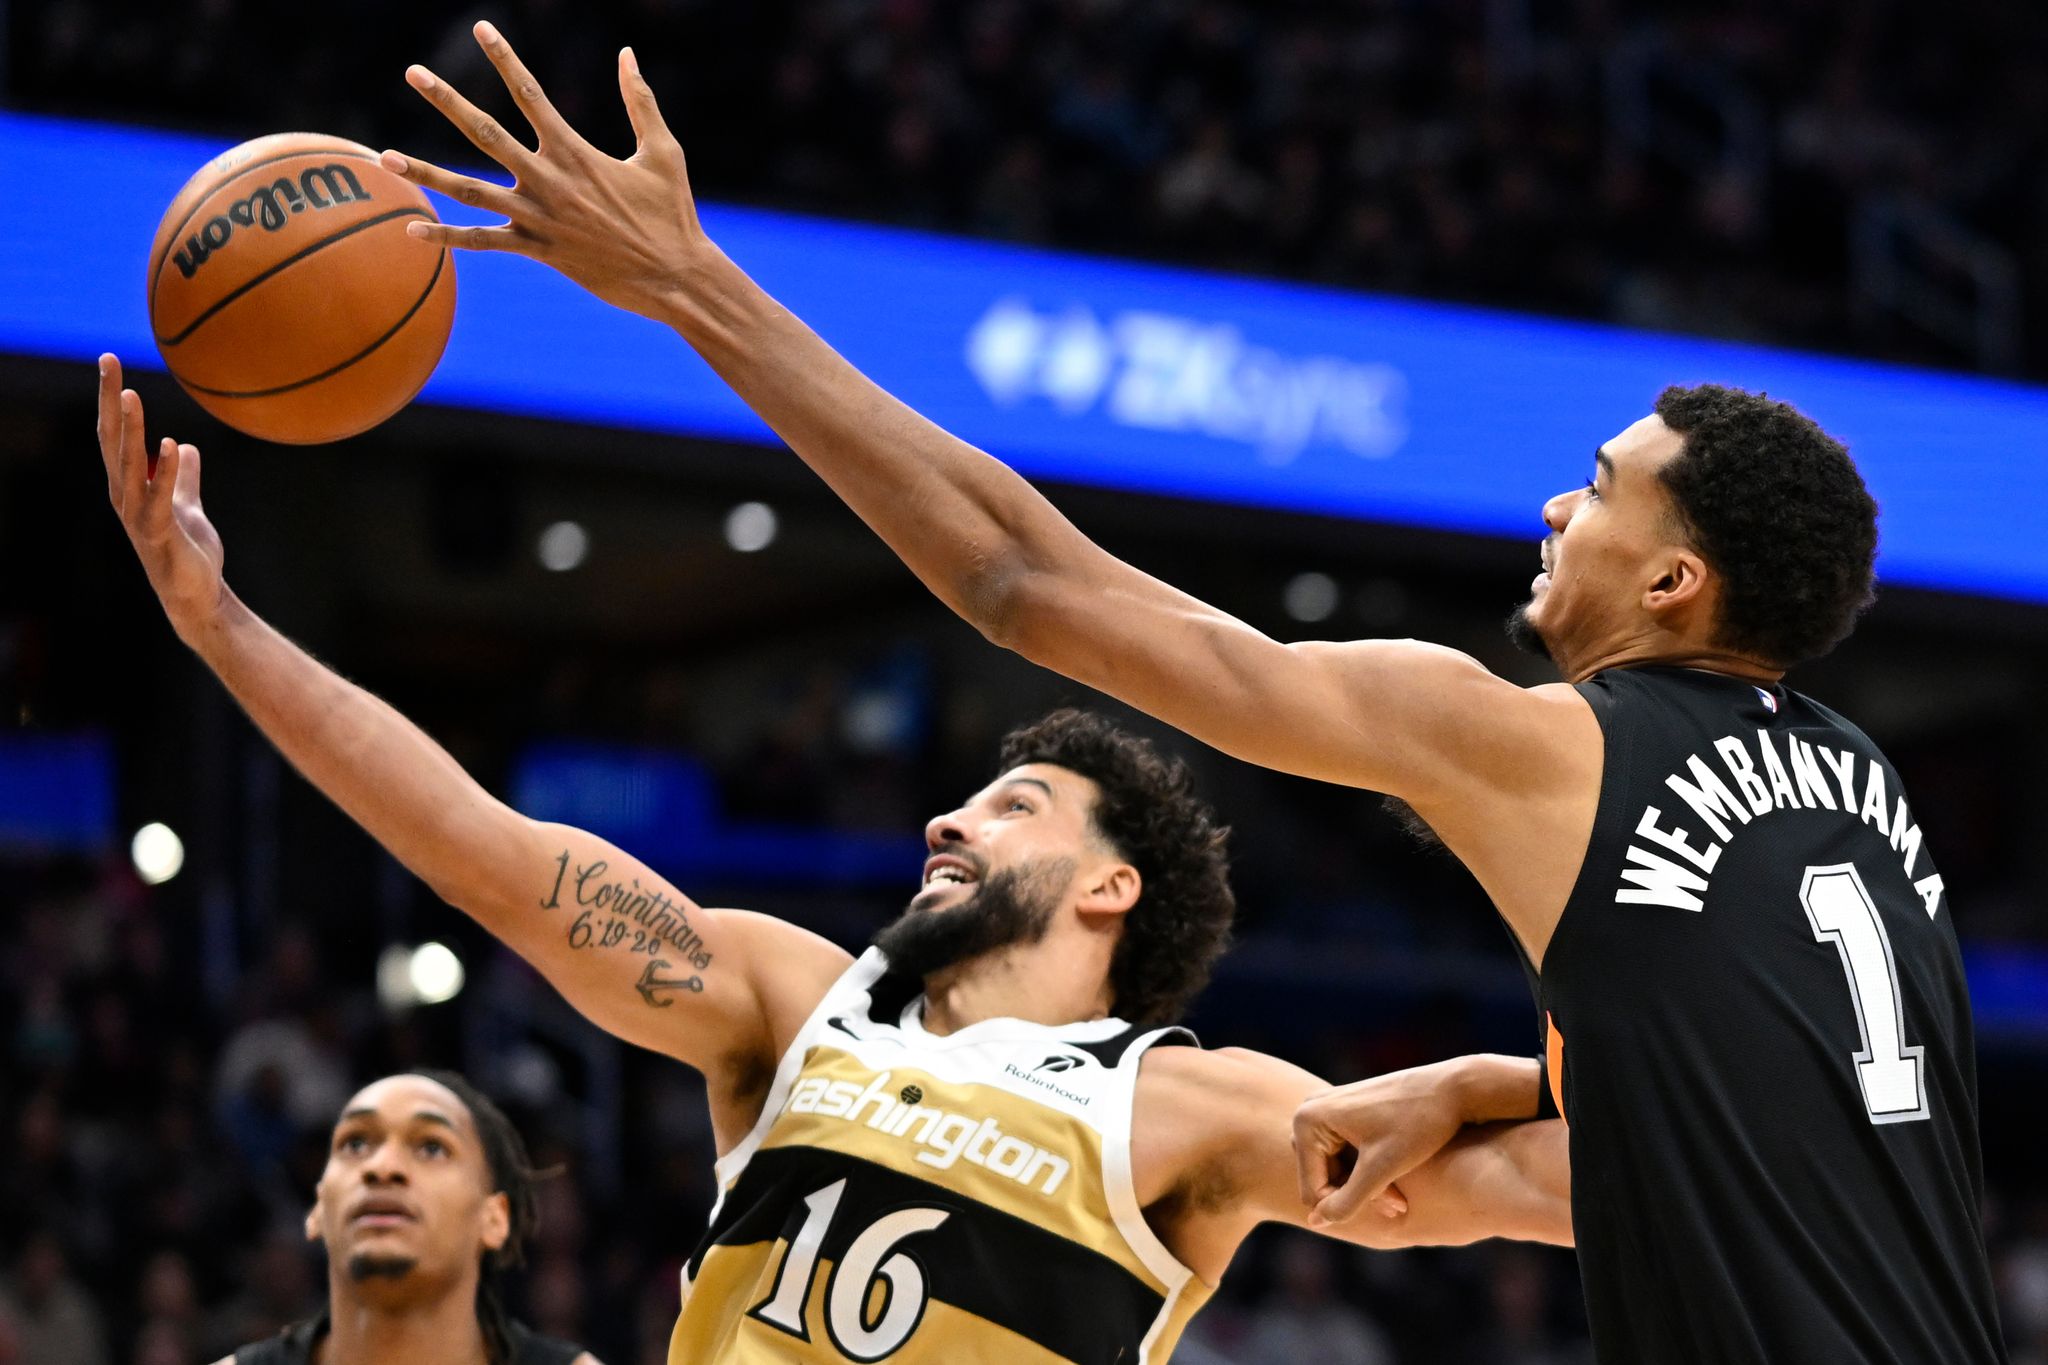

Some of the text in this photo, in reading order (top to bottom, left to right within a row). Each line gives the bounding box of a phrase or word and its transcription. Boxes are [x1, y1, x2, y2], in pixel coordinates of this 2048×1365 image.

[172, 162, 373, 279] Wilson
[1614, 728, 1945, 921] WEMBANYAMA
[539, 848, 714, 970] 1 Corinthians
[1799, 861, 1931, 1125] 1
[781, 1070, 1072, 1196] ashington
[1004, 1062, 1091, 1107] Robinhood
[747, 1176, 953, 1364] 16
